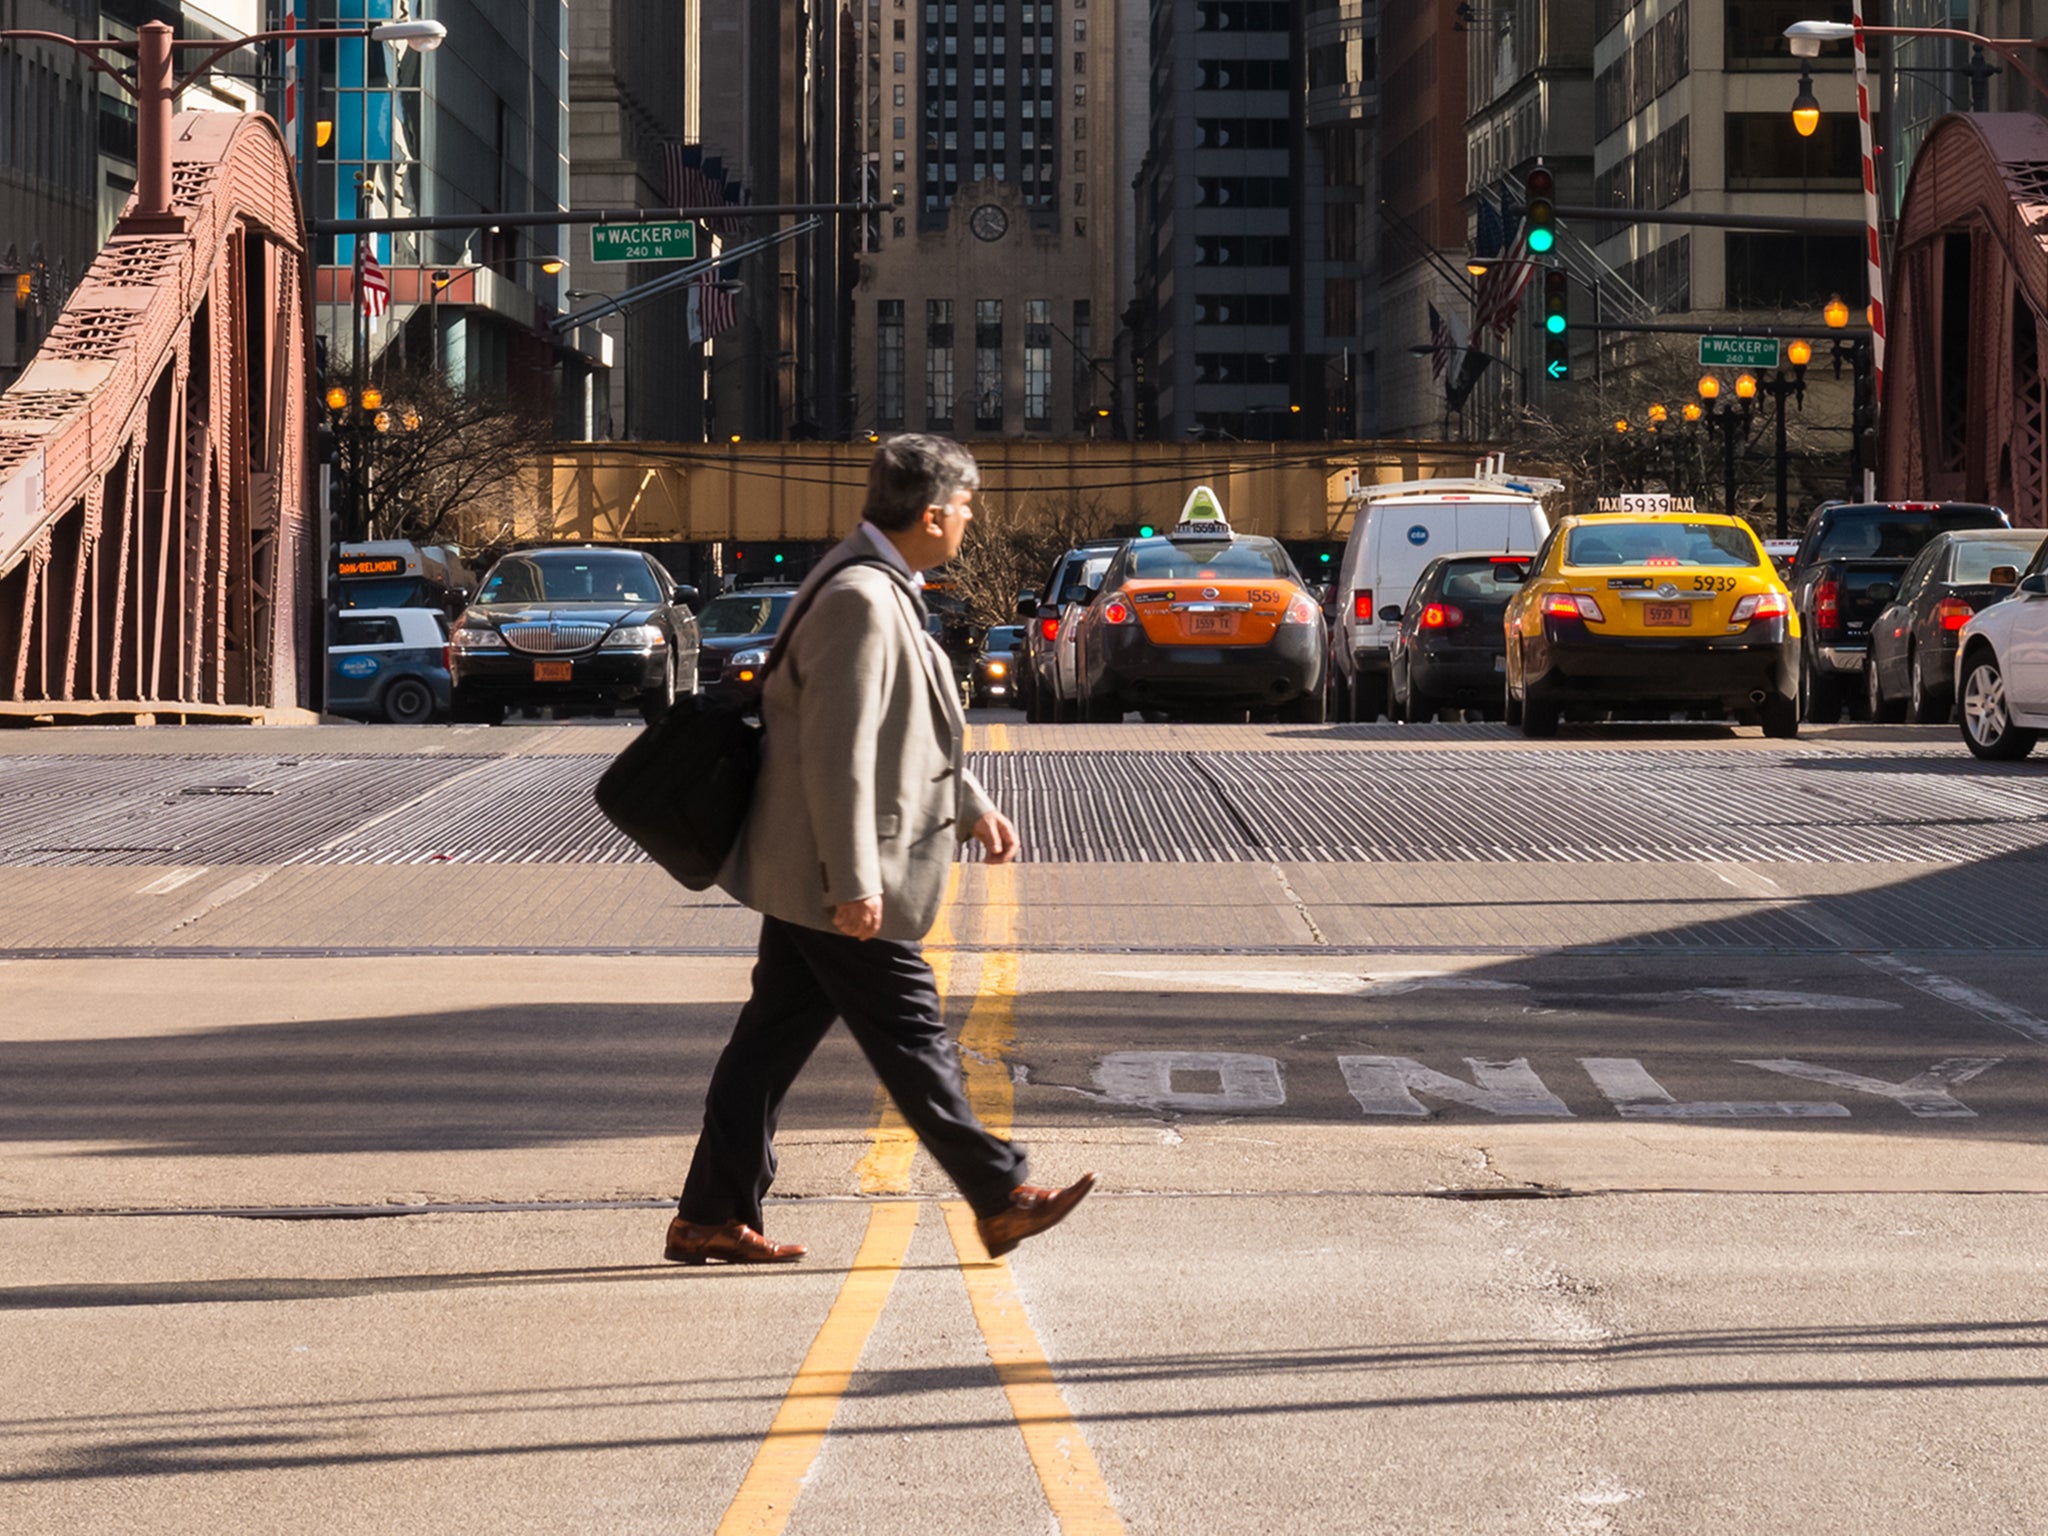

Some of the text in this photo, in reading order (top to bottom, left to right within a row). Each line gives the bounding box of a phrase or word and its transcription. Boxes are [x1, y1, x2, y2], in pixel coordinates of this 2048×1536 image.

[596, 227, 690, 244] W WACKER DR
[626, 246, 663, 257] 240 N
[1704, 340, 1775, 353] W WACKER DR
[1726, 354, 1755, 363] 240 N
[1598, 496, 1694, 512] TAXI 5939 TAXI
[1192, 523, 1215, 533] 1559
[1411, 531, 1426, 539] cta
[1693, 575, 1737, 592] 5939
[1247, 589, 1280, 603] 1559
[1650, 608, 1673, 620] 5939
[1195, 618, 1215, 629] 1559
[1087, 1050, 2006, 1119] ONLY
